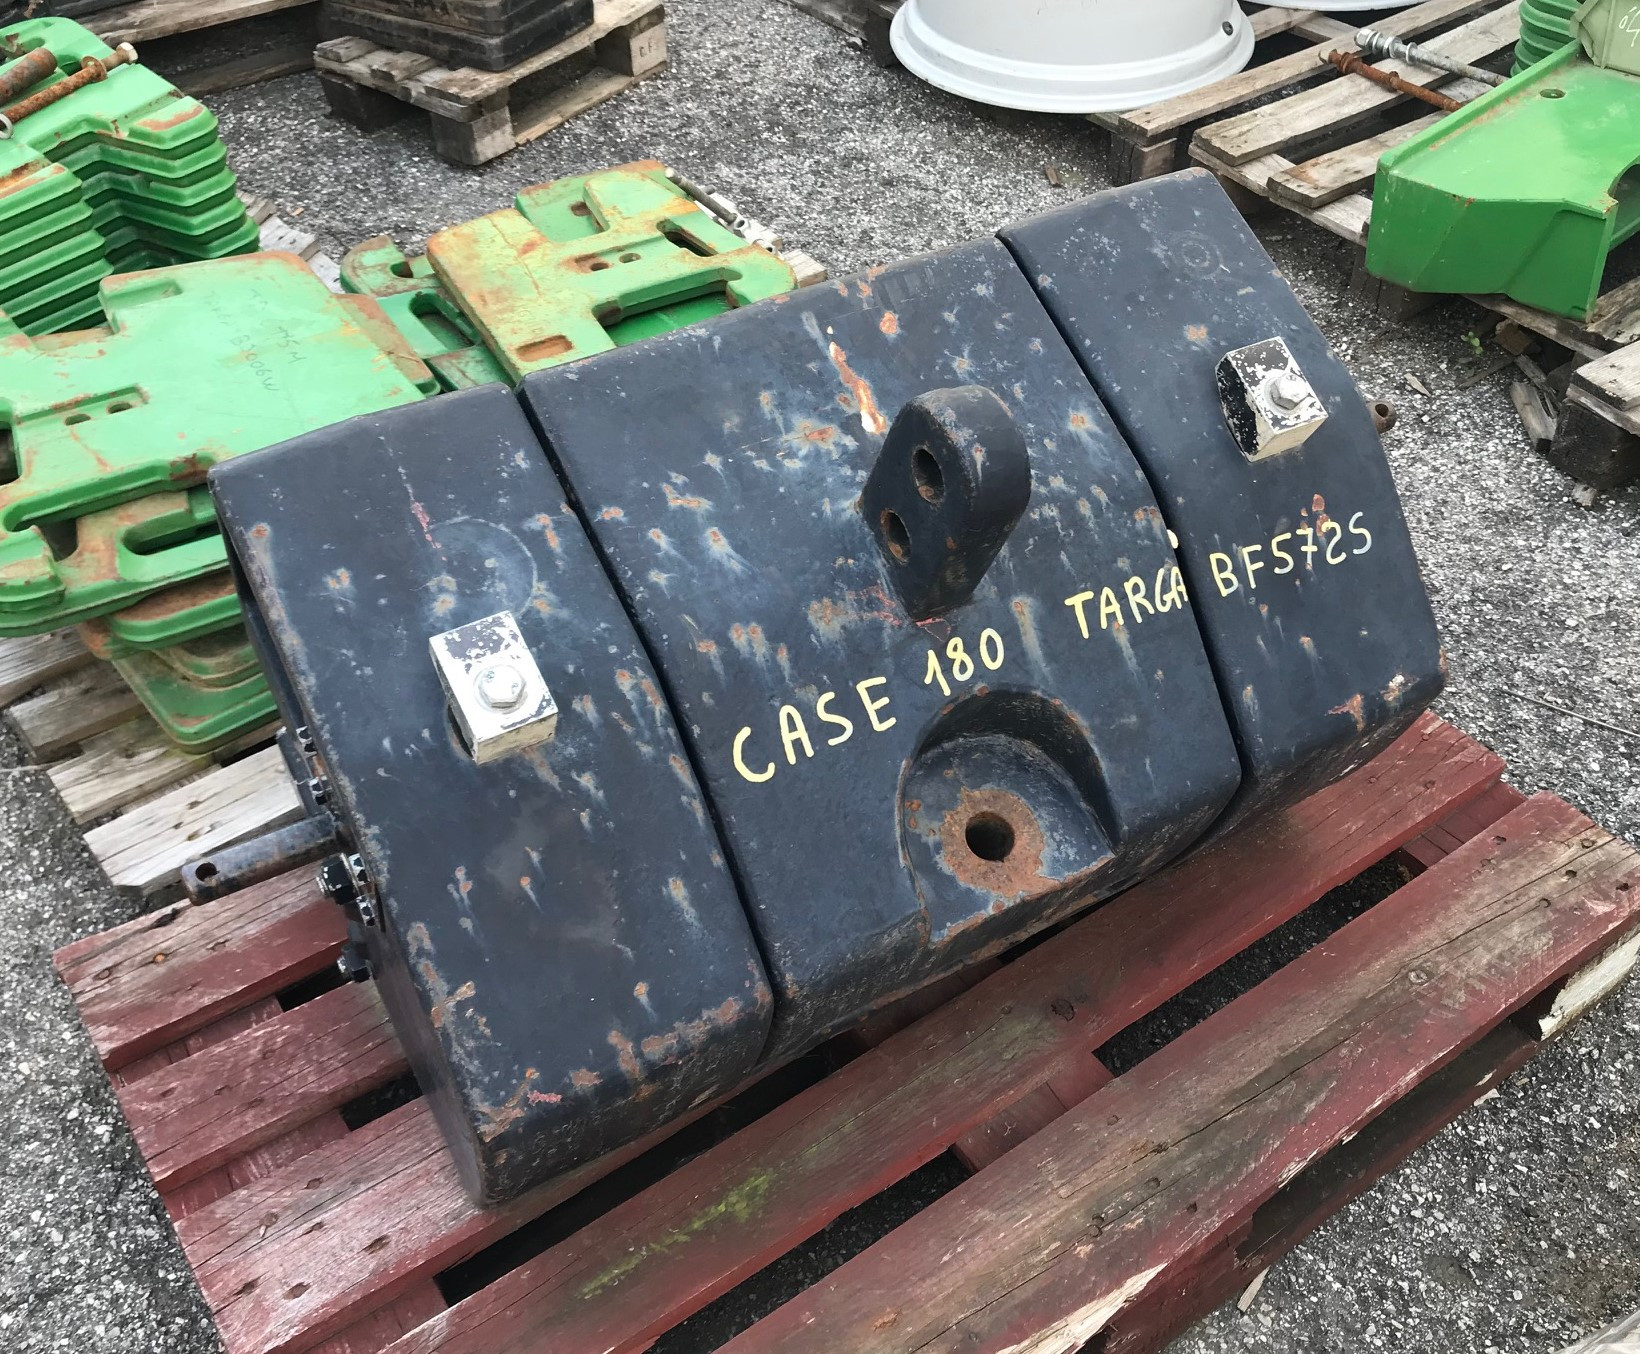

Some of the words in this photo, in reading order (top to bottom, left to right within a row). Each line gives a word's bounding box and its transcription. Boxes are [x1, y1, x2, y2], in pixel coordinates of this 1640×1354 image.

[732, 676, 897, 783] CASE
[923, 627, 1005, 697] 180
[1064, 565, 1189, 639] TARGA
